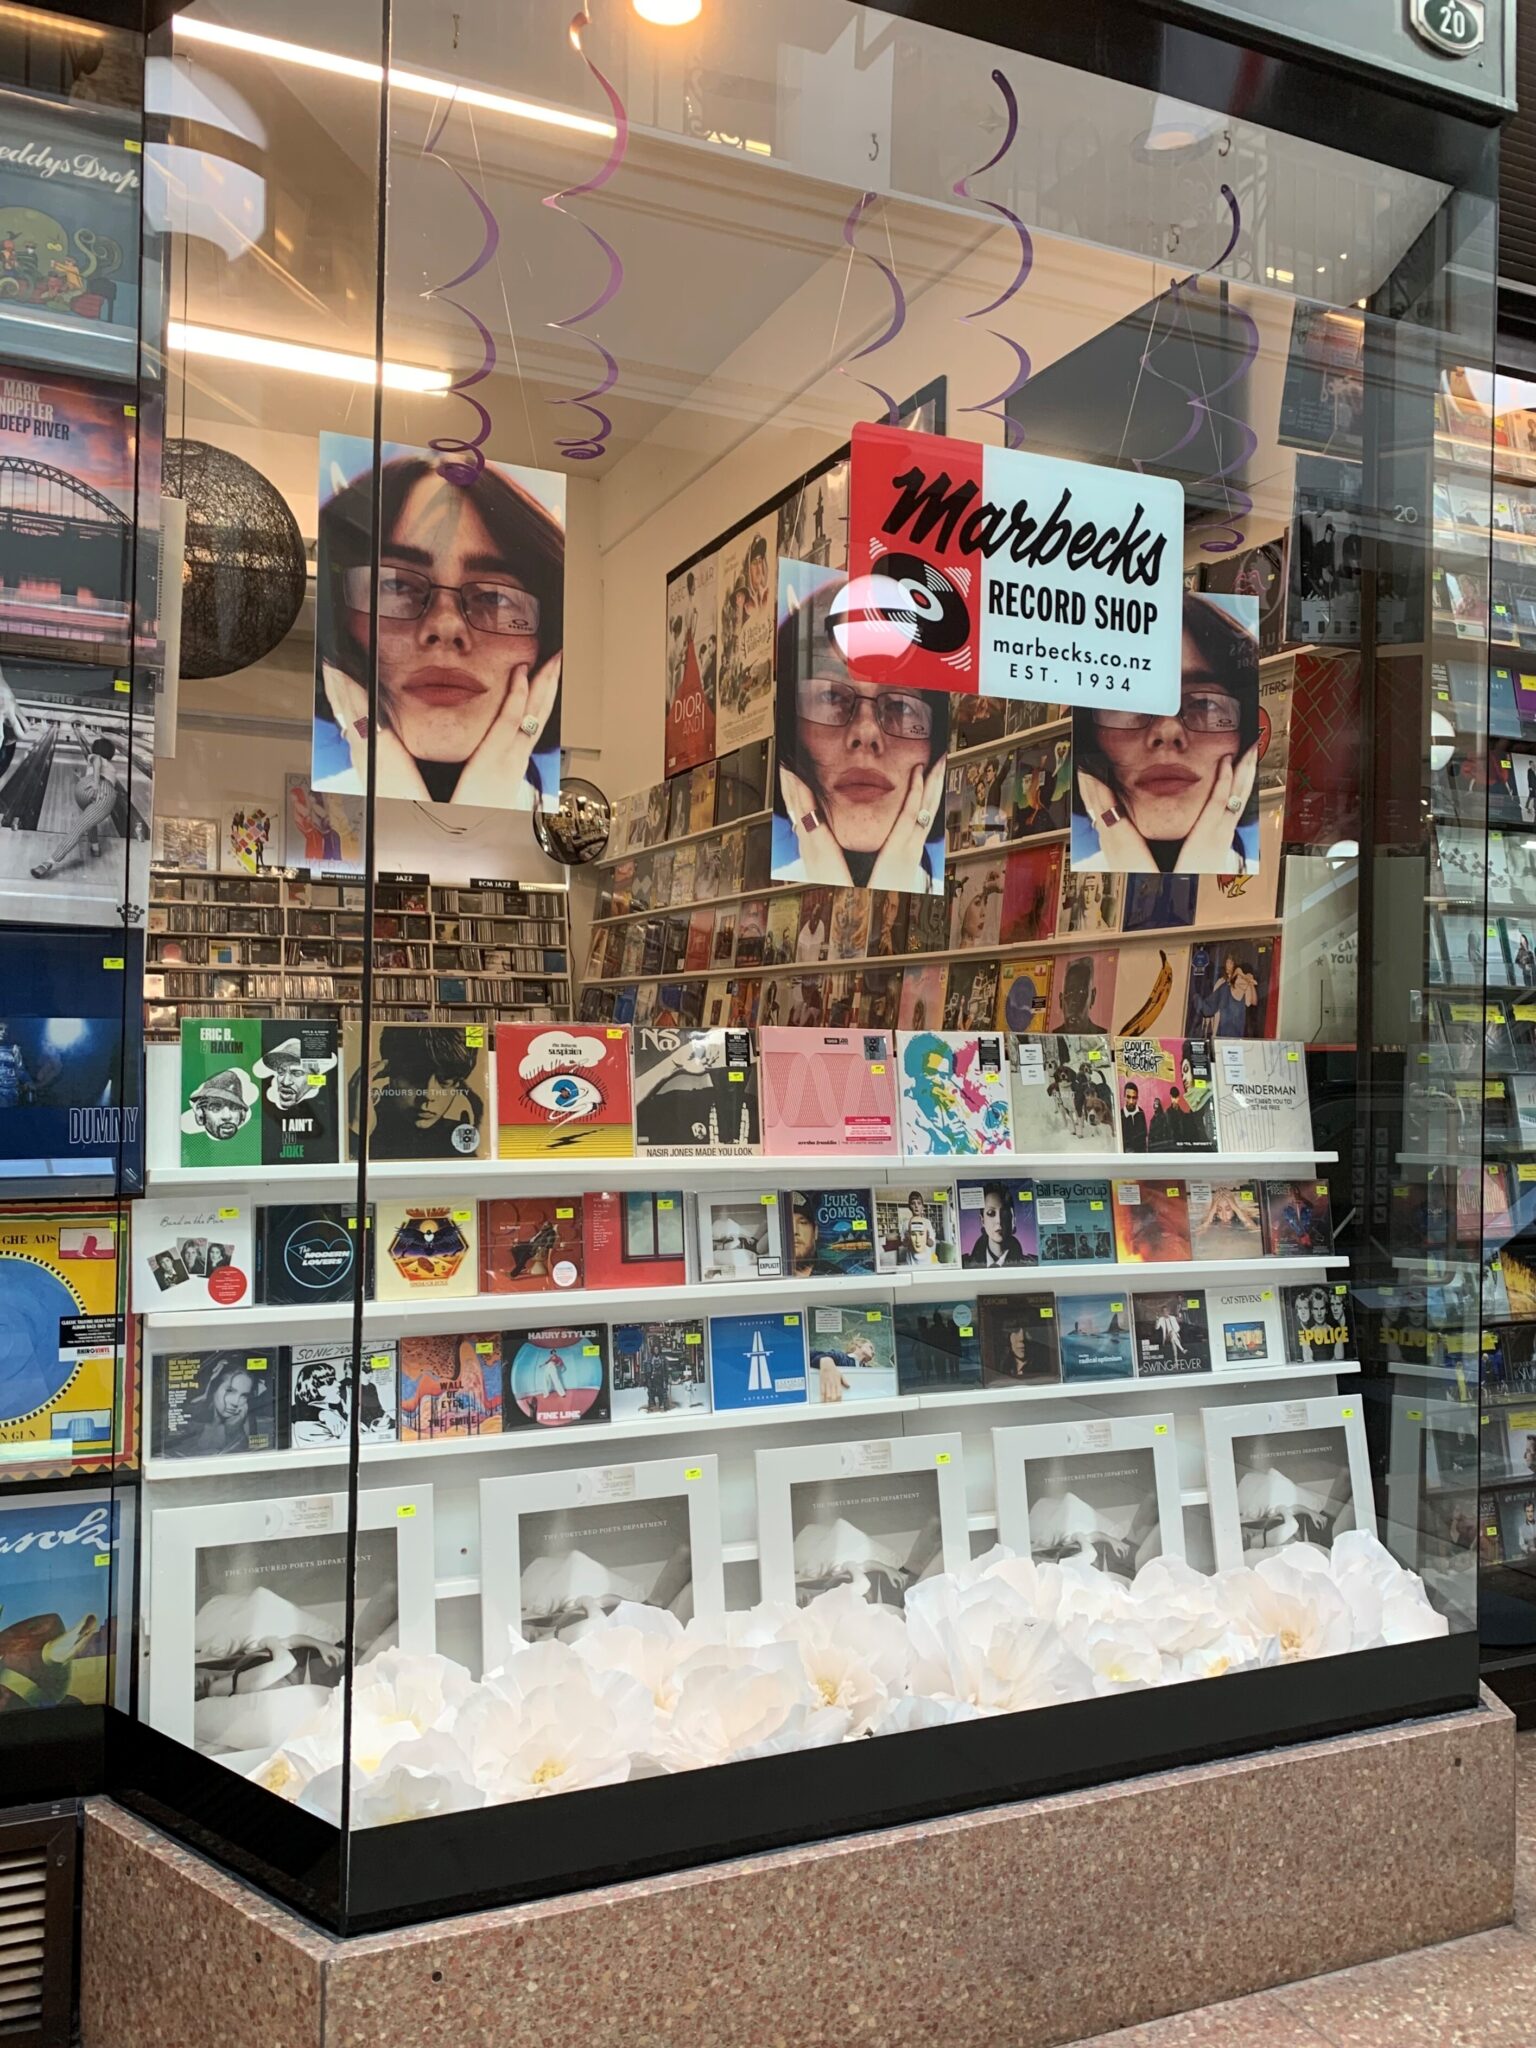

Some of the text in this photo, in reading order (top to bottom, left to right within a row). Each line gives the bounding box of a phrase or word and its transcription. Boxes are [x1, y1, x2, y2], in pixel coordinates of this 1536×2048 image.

[1440, 6, 1465, 38] 20
[73, 153, 140, 193] Drop
[4, 380, 40, 401] MARK
[0, 414, 70, 441] DEEP RIVER
[1394, 505, 1418, 523] 20
[881, 466, 1168, 587] Marbecks
[988, 579, 1158, 636] RECORD SHOP
[993, 637, 1153, 673] marbecks.co.nz
[1010, 663, 1132, 693] EST. 1934
[674, 692, 702, 724] DIOR
[395, 874, 414, 882] JAZZ
[200, 1027, 235, 1041] ERIC B.
[210, 1041, 244, 1054] RAKIM
[416, 1088, 425, 1097] OF
[430, 1089, 444, 1097] THE
[450, 1089, 470, 1097] CITY
[1231, 1084, 1297, 1096] GRINDERMAN
[69, 1106, 139, 1145] DUMMY
[282, 1118, 314, 1132] I AIN'T
[280, 1145, 304, 1158] JOKE
[646, 1147, 753, 1157] NASIR JONES MADE YOU LOOK
[1036, 1183, 1051, 1197] Bill
[1053, 1184, 1071, 1200] Fay
[1073, 1183, 1108, 1199] Group
[824, 1193, 858, 1207] LUKE
[818, 1205, 866, 1224] COMBS
[304, 1250, 351, 1259] MODERN
[302, 1258, 343, 1266] LOVERS
[759, 1261, 780, 1271] EXPLICIT
[1221, 1293, 1262, 1305] CAT STEVENS
[527, 1330, 597, 1340] HARRY STYLES
[1305, 1326, 1350, 1346] POLICE
[296, 1347, 334, 1360] SONIC
[1143, 1358, 1202, 1373] SWING FEVER
[440, 1380, 464, 1390] WALL
[536, 1410, 581, 1420] FINE LINE
[224, 1554, 373, 1577] THE TORTURED POETS DEPARTENT
